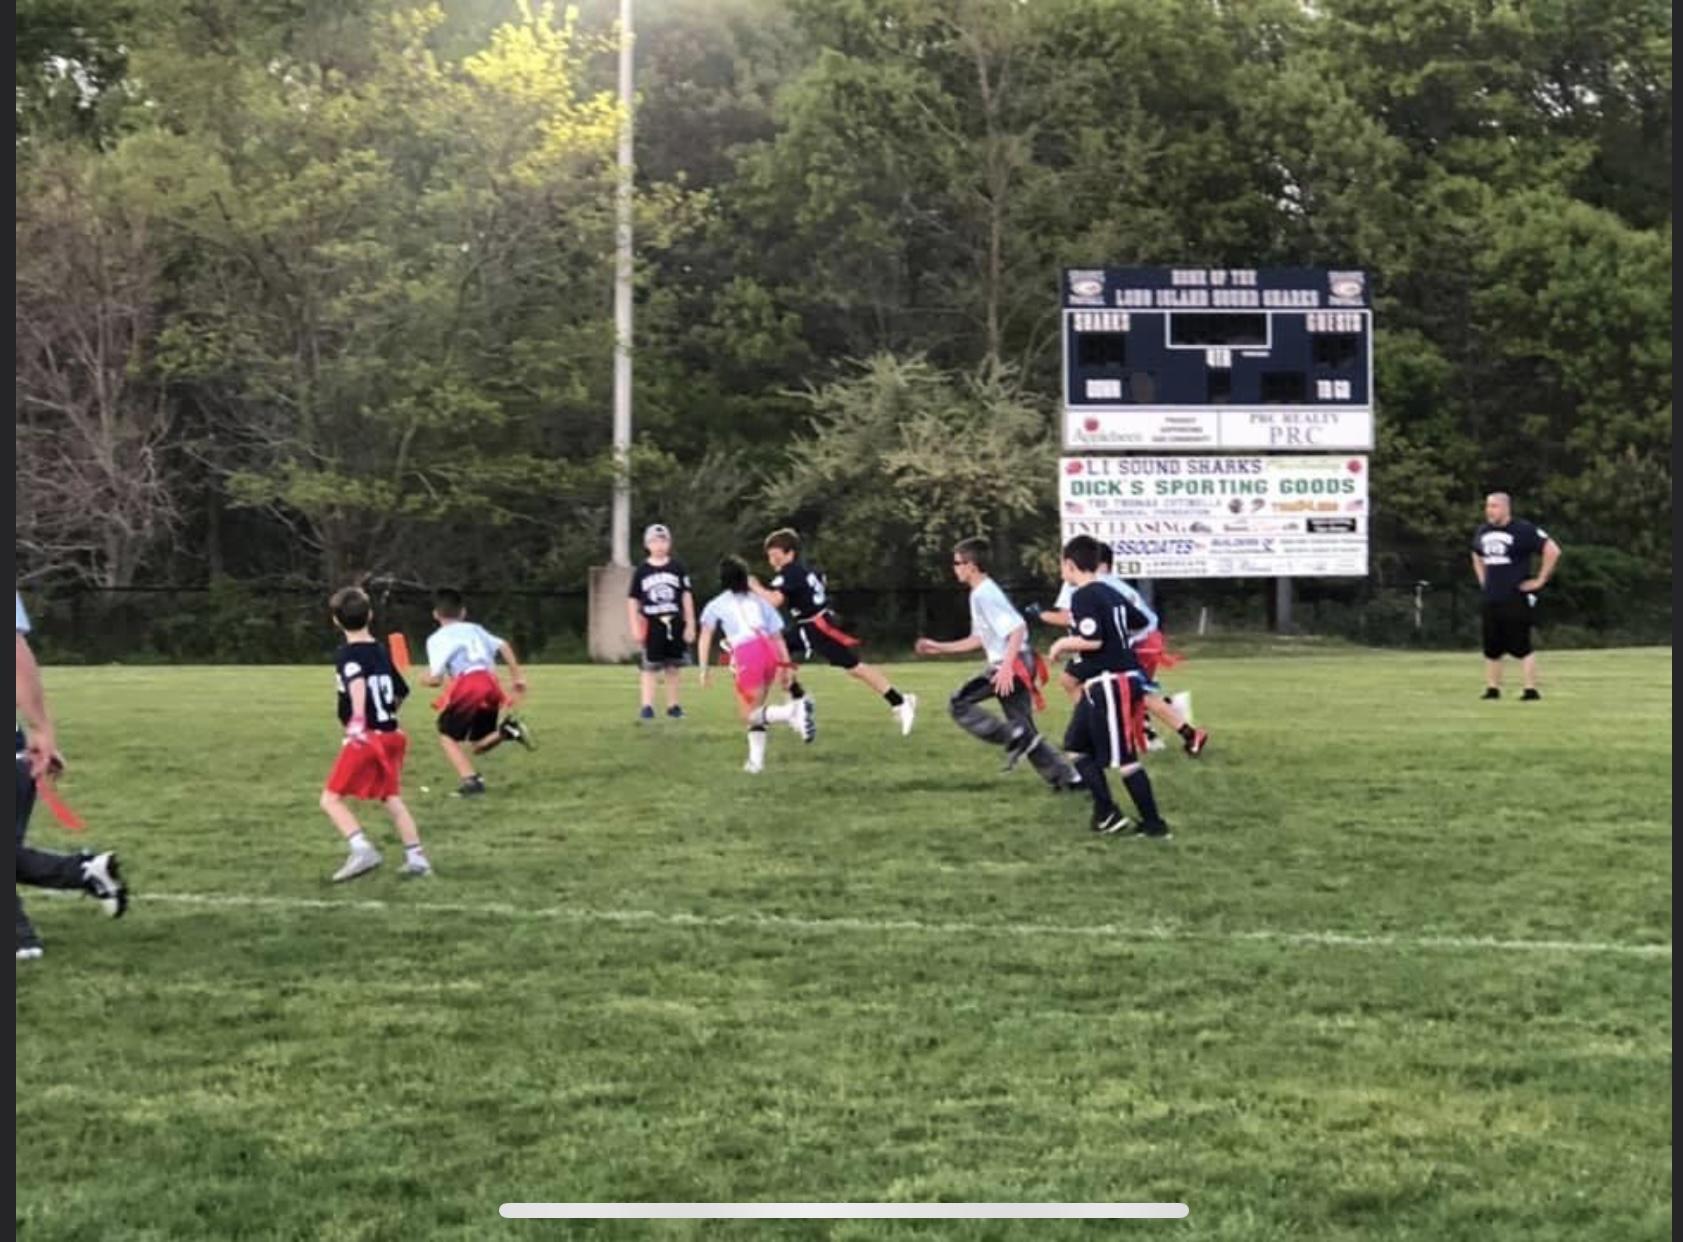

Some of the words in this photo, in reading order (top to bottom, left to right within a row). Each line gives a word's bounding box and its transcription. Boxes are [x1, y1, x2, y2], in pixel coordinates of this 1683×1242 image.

[1269, 426, 1323, 445] PRC
[1119, 459, 1181, 475] SOUND
[1187, 458, 1263, 475] SHARKS
[1070, 479, 1145, 496] DICK'S
[1154, 478, 1269, 496] SPORTING
[1278, 477, 1356, 495] GOODS
